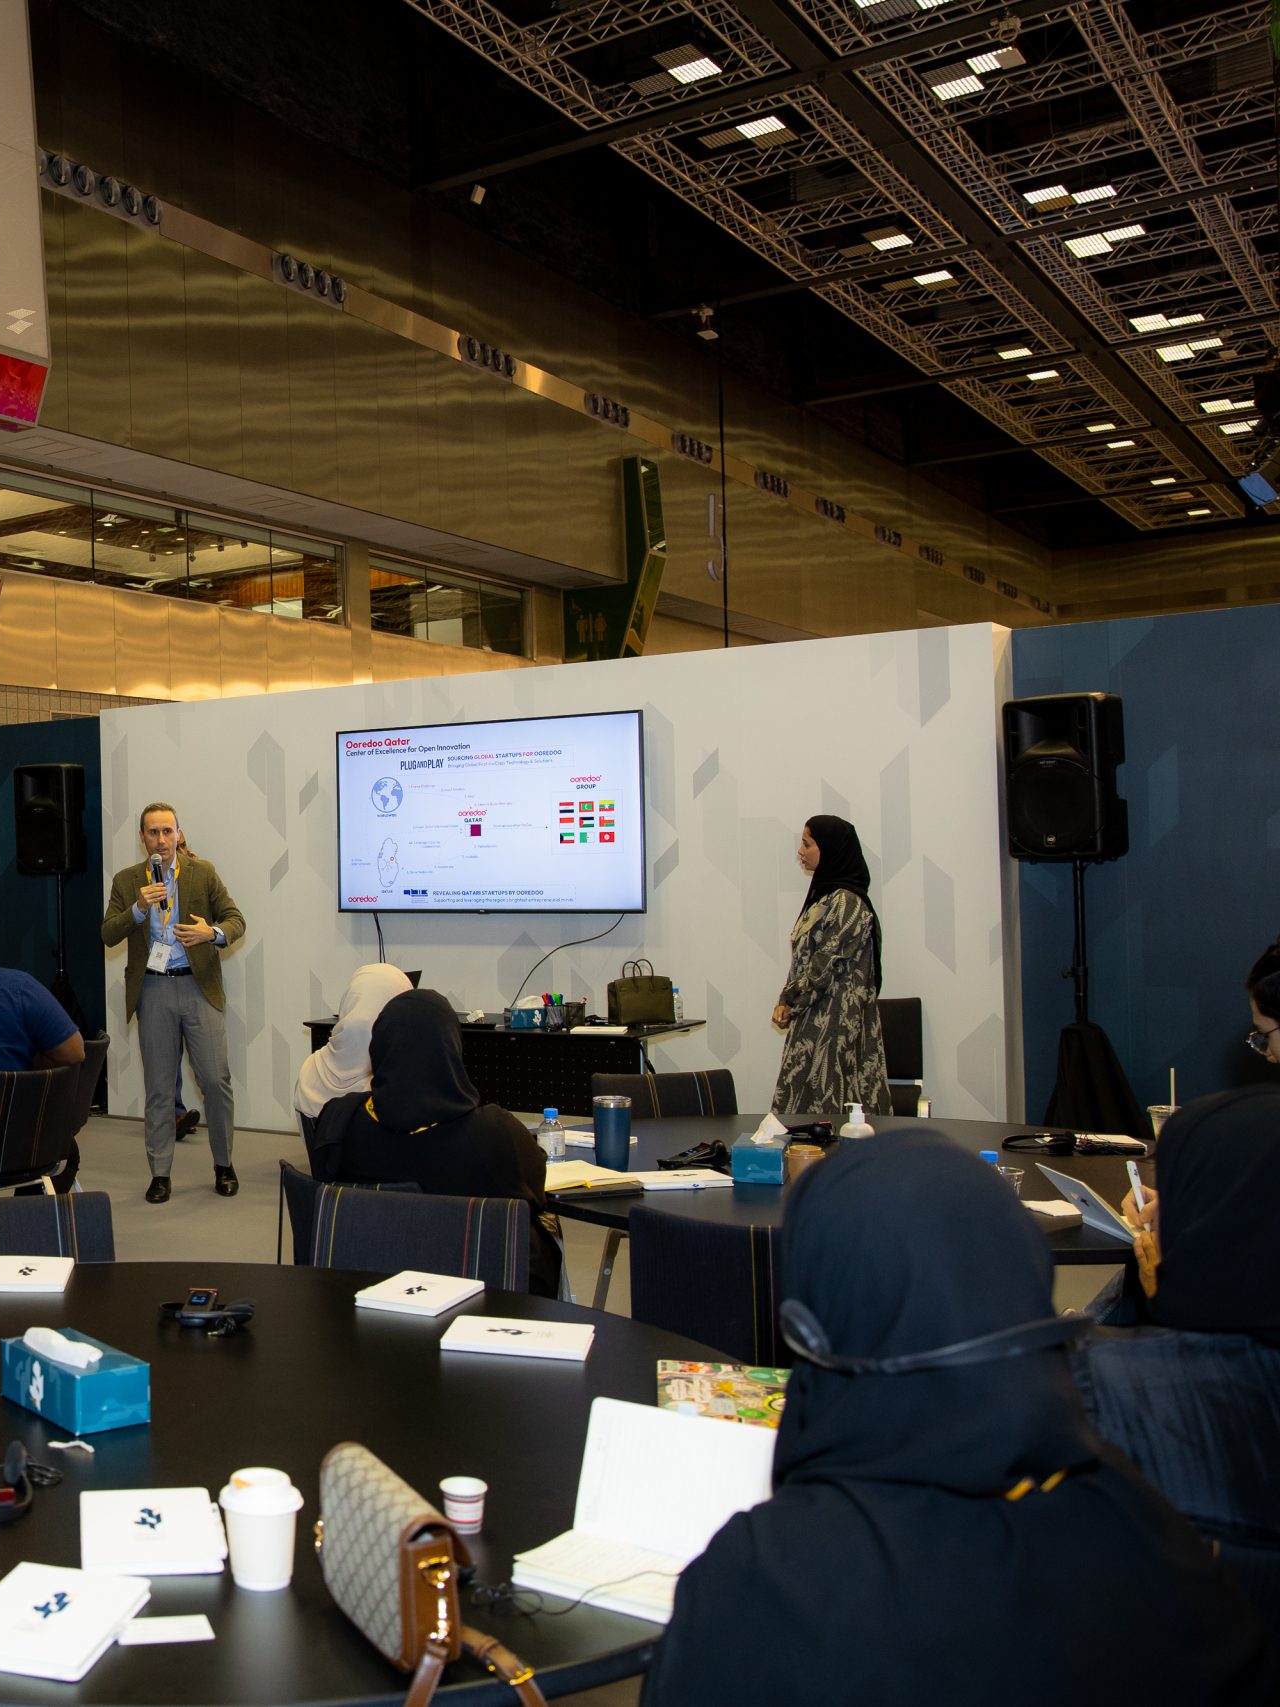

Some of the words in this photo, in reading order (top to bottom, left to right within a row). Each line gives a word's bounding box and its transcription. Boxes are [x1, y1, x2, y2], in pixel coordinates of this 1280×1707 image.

[345, 739, 382, 749] Ooredoo
[384, 738, 410, 747] Qatar
[375, 747, 406, 755] Excellence
[418, 746, 436, 754] Open
[436, 743, 470, 751] Innovation
[570, 774, 602, 782] ooredoo
